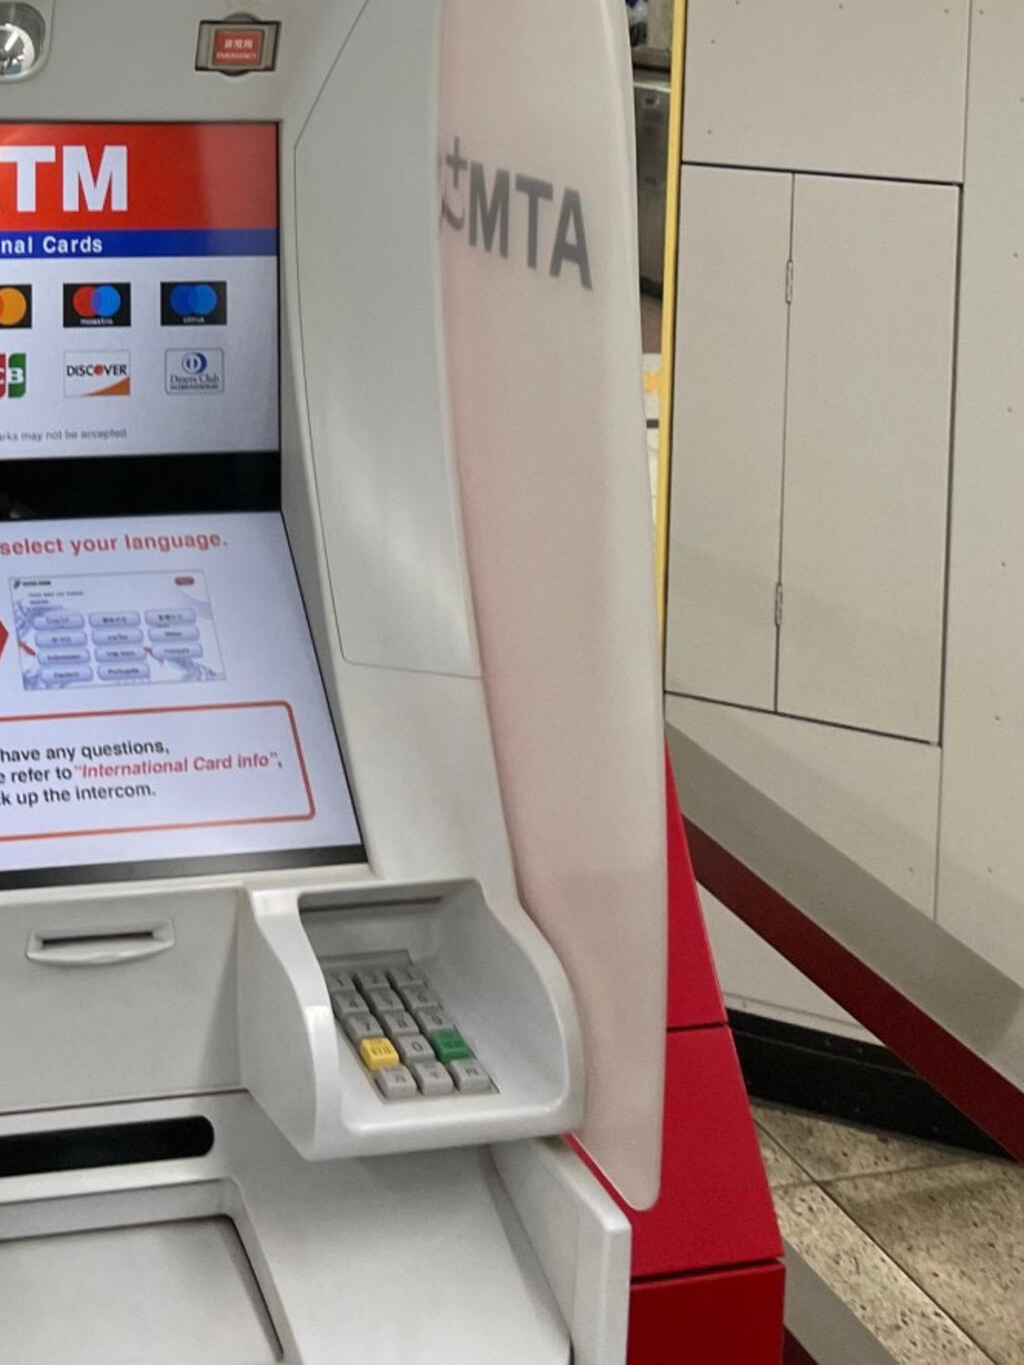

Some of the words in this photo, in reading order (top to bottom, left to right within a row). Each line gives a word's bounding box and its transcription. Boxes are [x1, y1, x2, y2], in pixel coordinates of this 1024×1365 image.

[42, 235, 103, 254] Cards
[66, 363, 127, 377] DISCOVER
[21, 432, 41, 443] may
[46, 430, 62, 440] not
[65, 429, 77, 439] be
[0, 538, 64, 556] select
[70, 536, 118, 555] your
[124, 532, 228, 552] language.
[0, 748, 40, 763] have
[46, 747, 75, 762] any
[81, 740, 170, 760] questions,
[11, 767, 49, 783] refer
[56, 767, 72, 780] to
[193, 753, 232, 772] Card
[17, 791, 38, 807] up
[44, 788, 71, 803] the
[76, 784, 156, 801] intercom.
